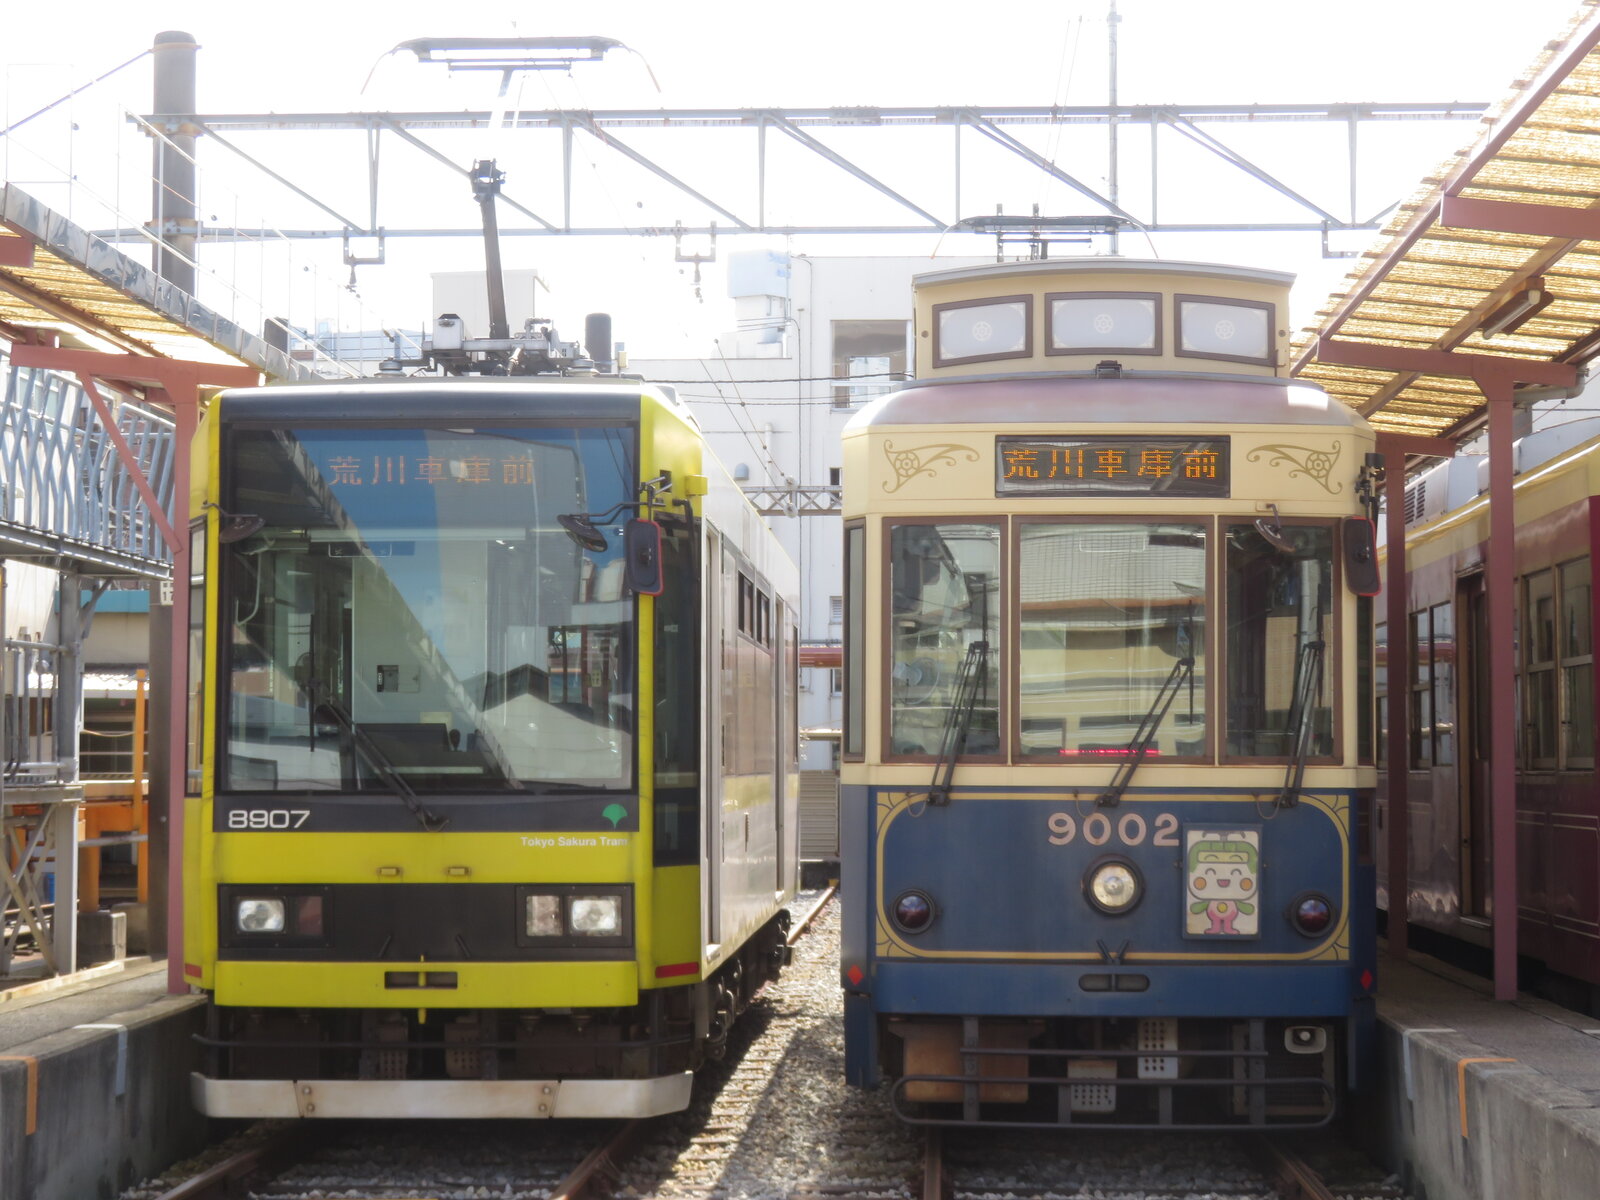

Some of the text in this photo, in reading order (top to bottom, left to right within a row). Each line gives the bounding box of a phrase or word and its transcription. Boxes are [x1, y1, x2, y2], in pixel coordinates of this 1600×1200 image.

[328, 455, 535, 486] 荒川車庫前
[1002, 449, 1219, 478] 荒川車庫前
[228, 809, 311, 829] 8907
[1047, 812, 1180, 847] 9002
[520, 836, 629, 848] Tokyo Sakura Tram
